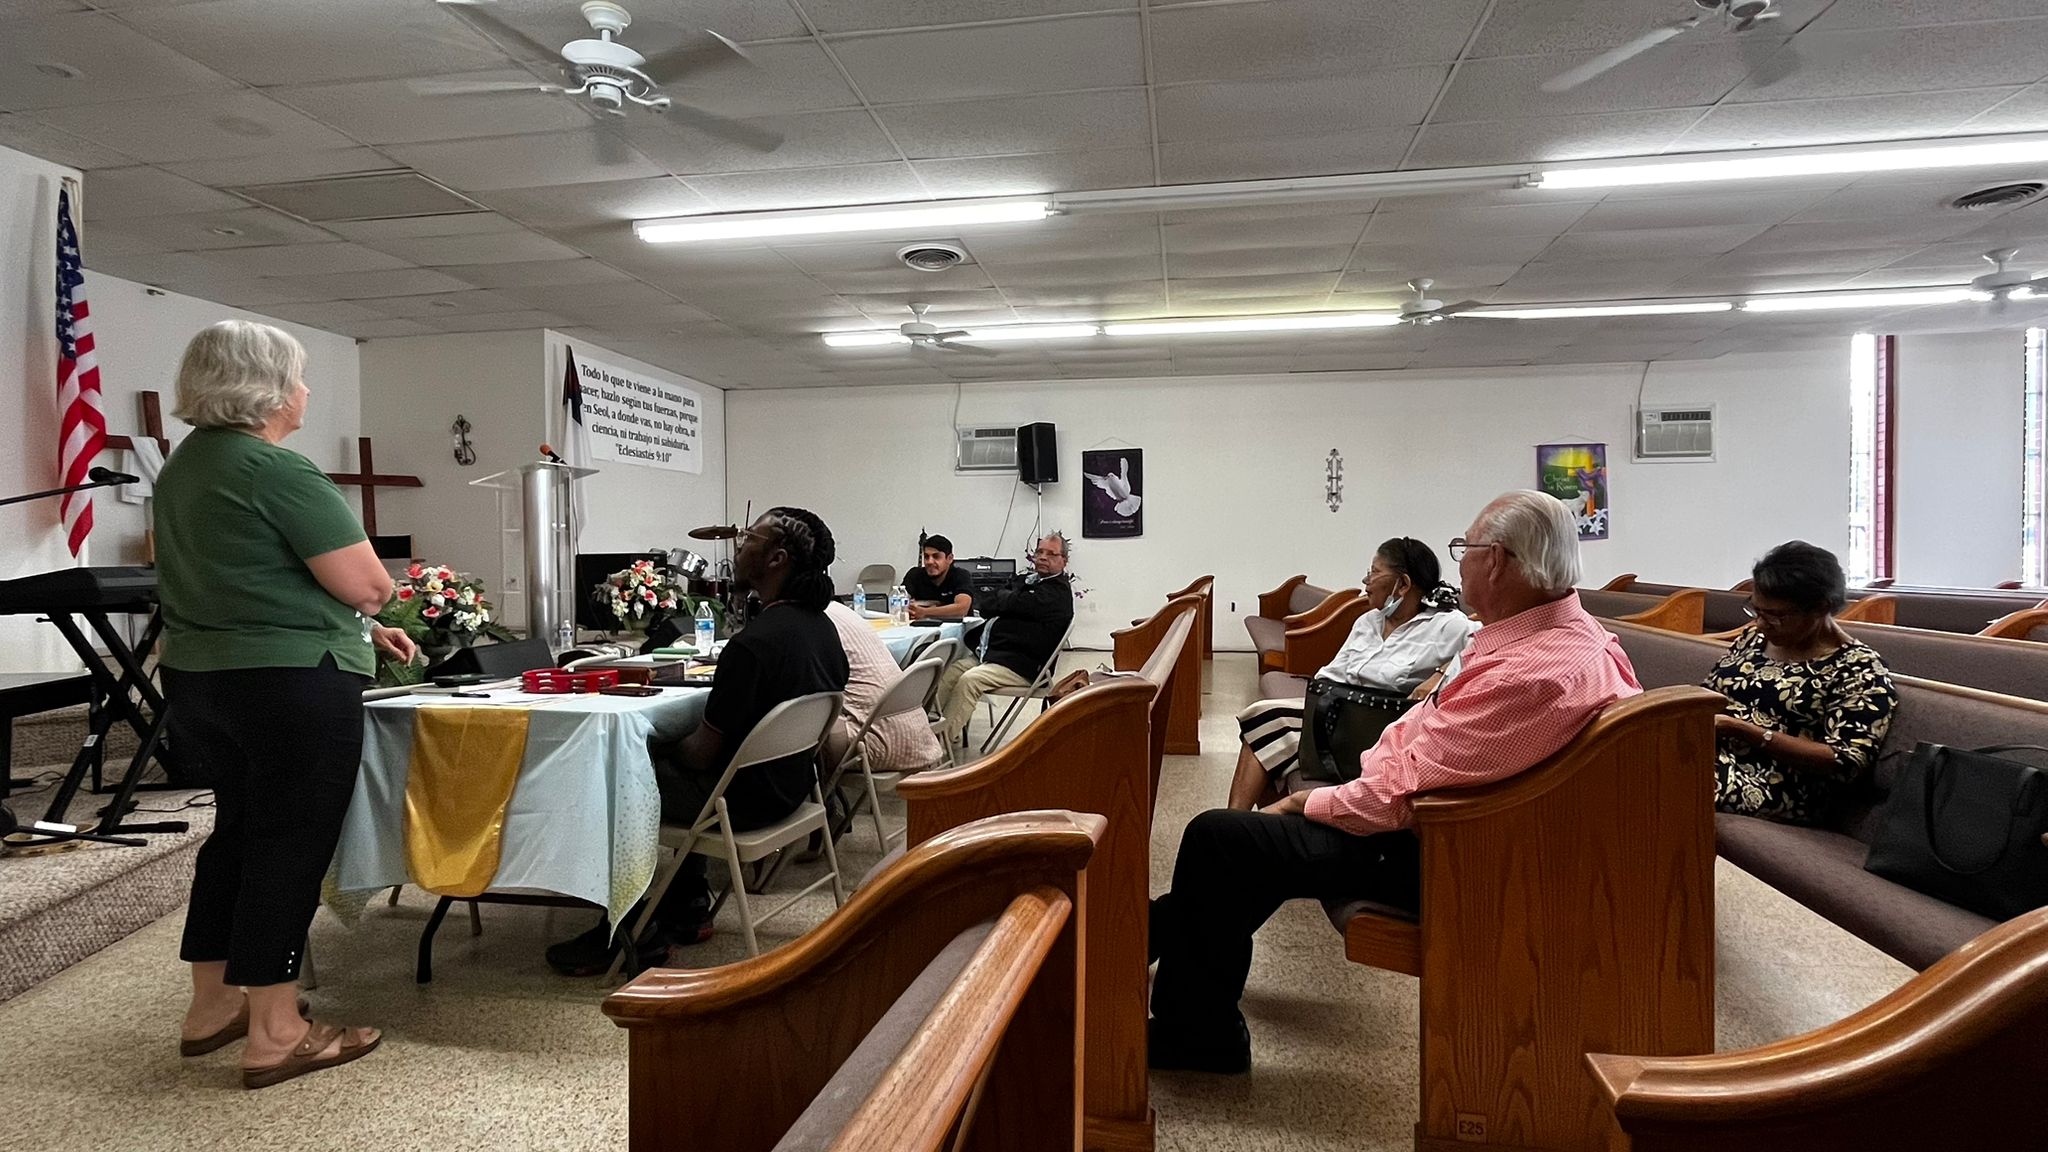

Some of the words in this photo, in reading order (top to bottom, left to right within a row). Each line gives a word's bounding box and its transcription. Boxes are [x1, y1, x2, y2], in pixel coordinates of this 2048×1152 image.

[581, 364, 601, 380] Todo
[602, 370, 609, 382] lo
[610, 375, 625, 388] que
[626, 378, 633, 389] te
[633, 381, 651, 395] viene
[652, 387, 657, 396] a
[657, 387, 663, 399] la
[664, 392, 682, 403] mano
[683, 397, 695, 408] para
[593, 403, 610, 419] Seol,
[611, 410, 616, 419] a
[617, 409, 639, 424] donde
[640, 417, 653, 429] vas,
[654, 420, 662, 430] no
[663, 420, 673, 434] hay
[674, 424, 690, 437] obra,
[601, 387, 620, 403] hazlo
[642, 401, 653, 412] tus
[654, 402, 678, 420] fuerzas,
[680, 411, 698, 426] porque
[592, 422, 619, 438] ciencia,
[620, 428, 627, 438] ni
[628, 429, 652, 445] trabajo
[654, 435, 660, 445] ni
